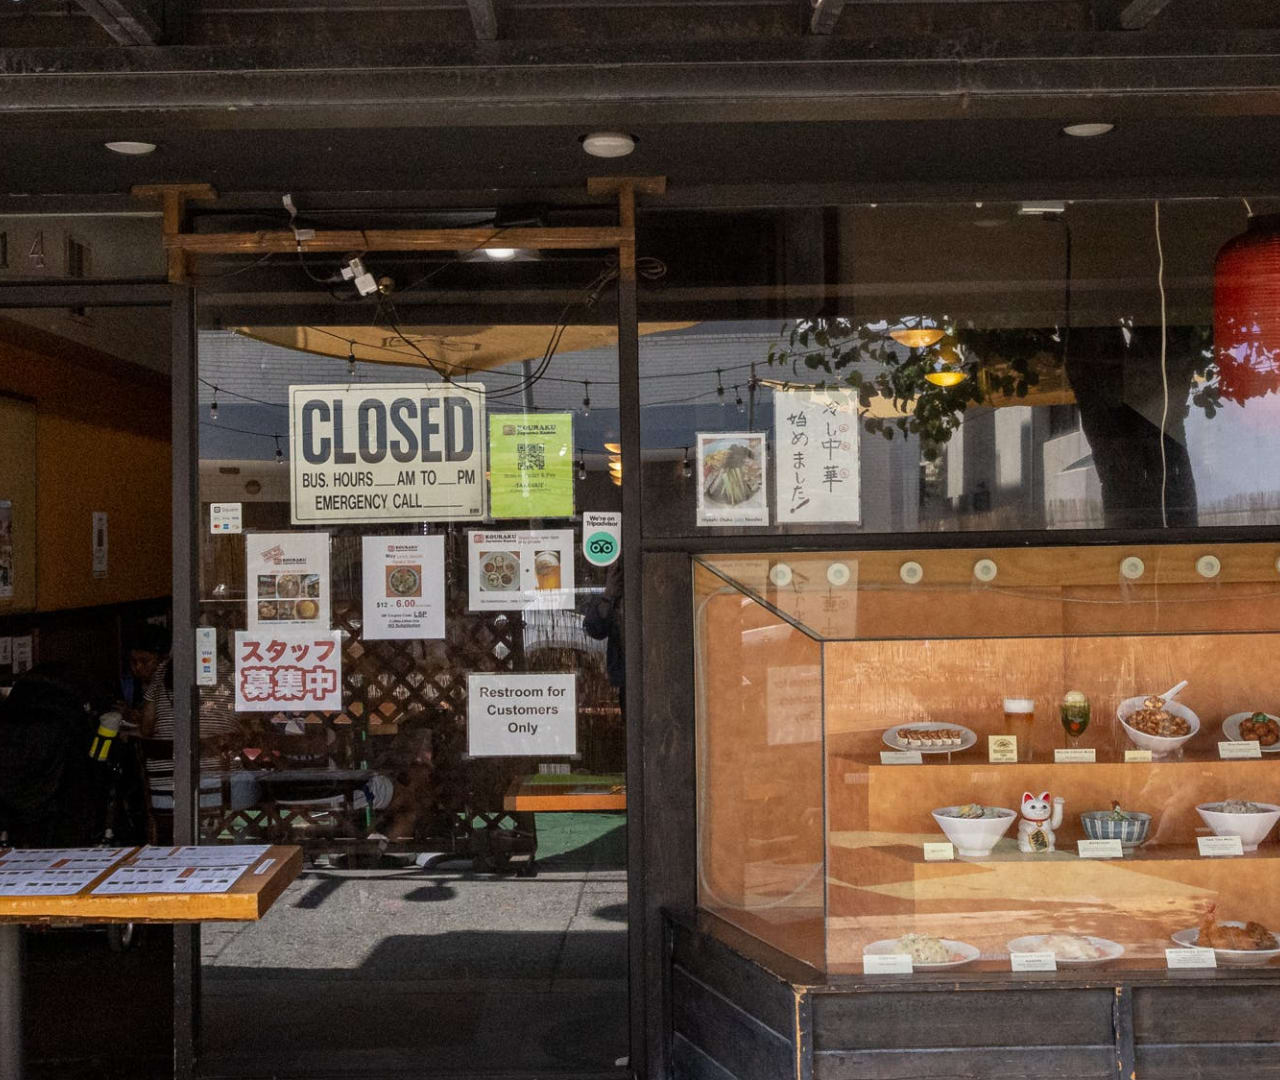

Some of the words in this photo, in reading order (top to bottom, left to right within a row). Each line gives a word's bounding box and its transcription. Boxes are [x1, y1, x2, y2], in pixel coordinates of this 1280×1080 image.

[302, 397, 473, 464] CLOSED
[302, 472, 329, 488] BUS.
[333, 472, 373, 488] HOURS
[397, 471, 416, 486] AM
[420, 470, 437, 485] TO
[457, 470, 475, 485] PM
[315, 494, 388, 510] EMERGENCY
[393, 494, 422, 509] CALL
[241, 640, 335, 663] スタッフ
[241, 665, 336, 702] 募集中
[480, 687, 543, 698] Restroom
[547, 686, 566, 697] for
[487, 704, 559, 716] Customers
[508, 722, 538, 735] Only
